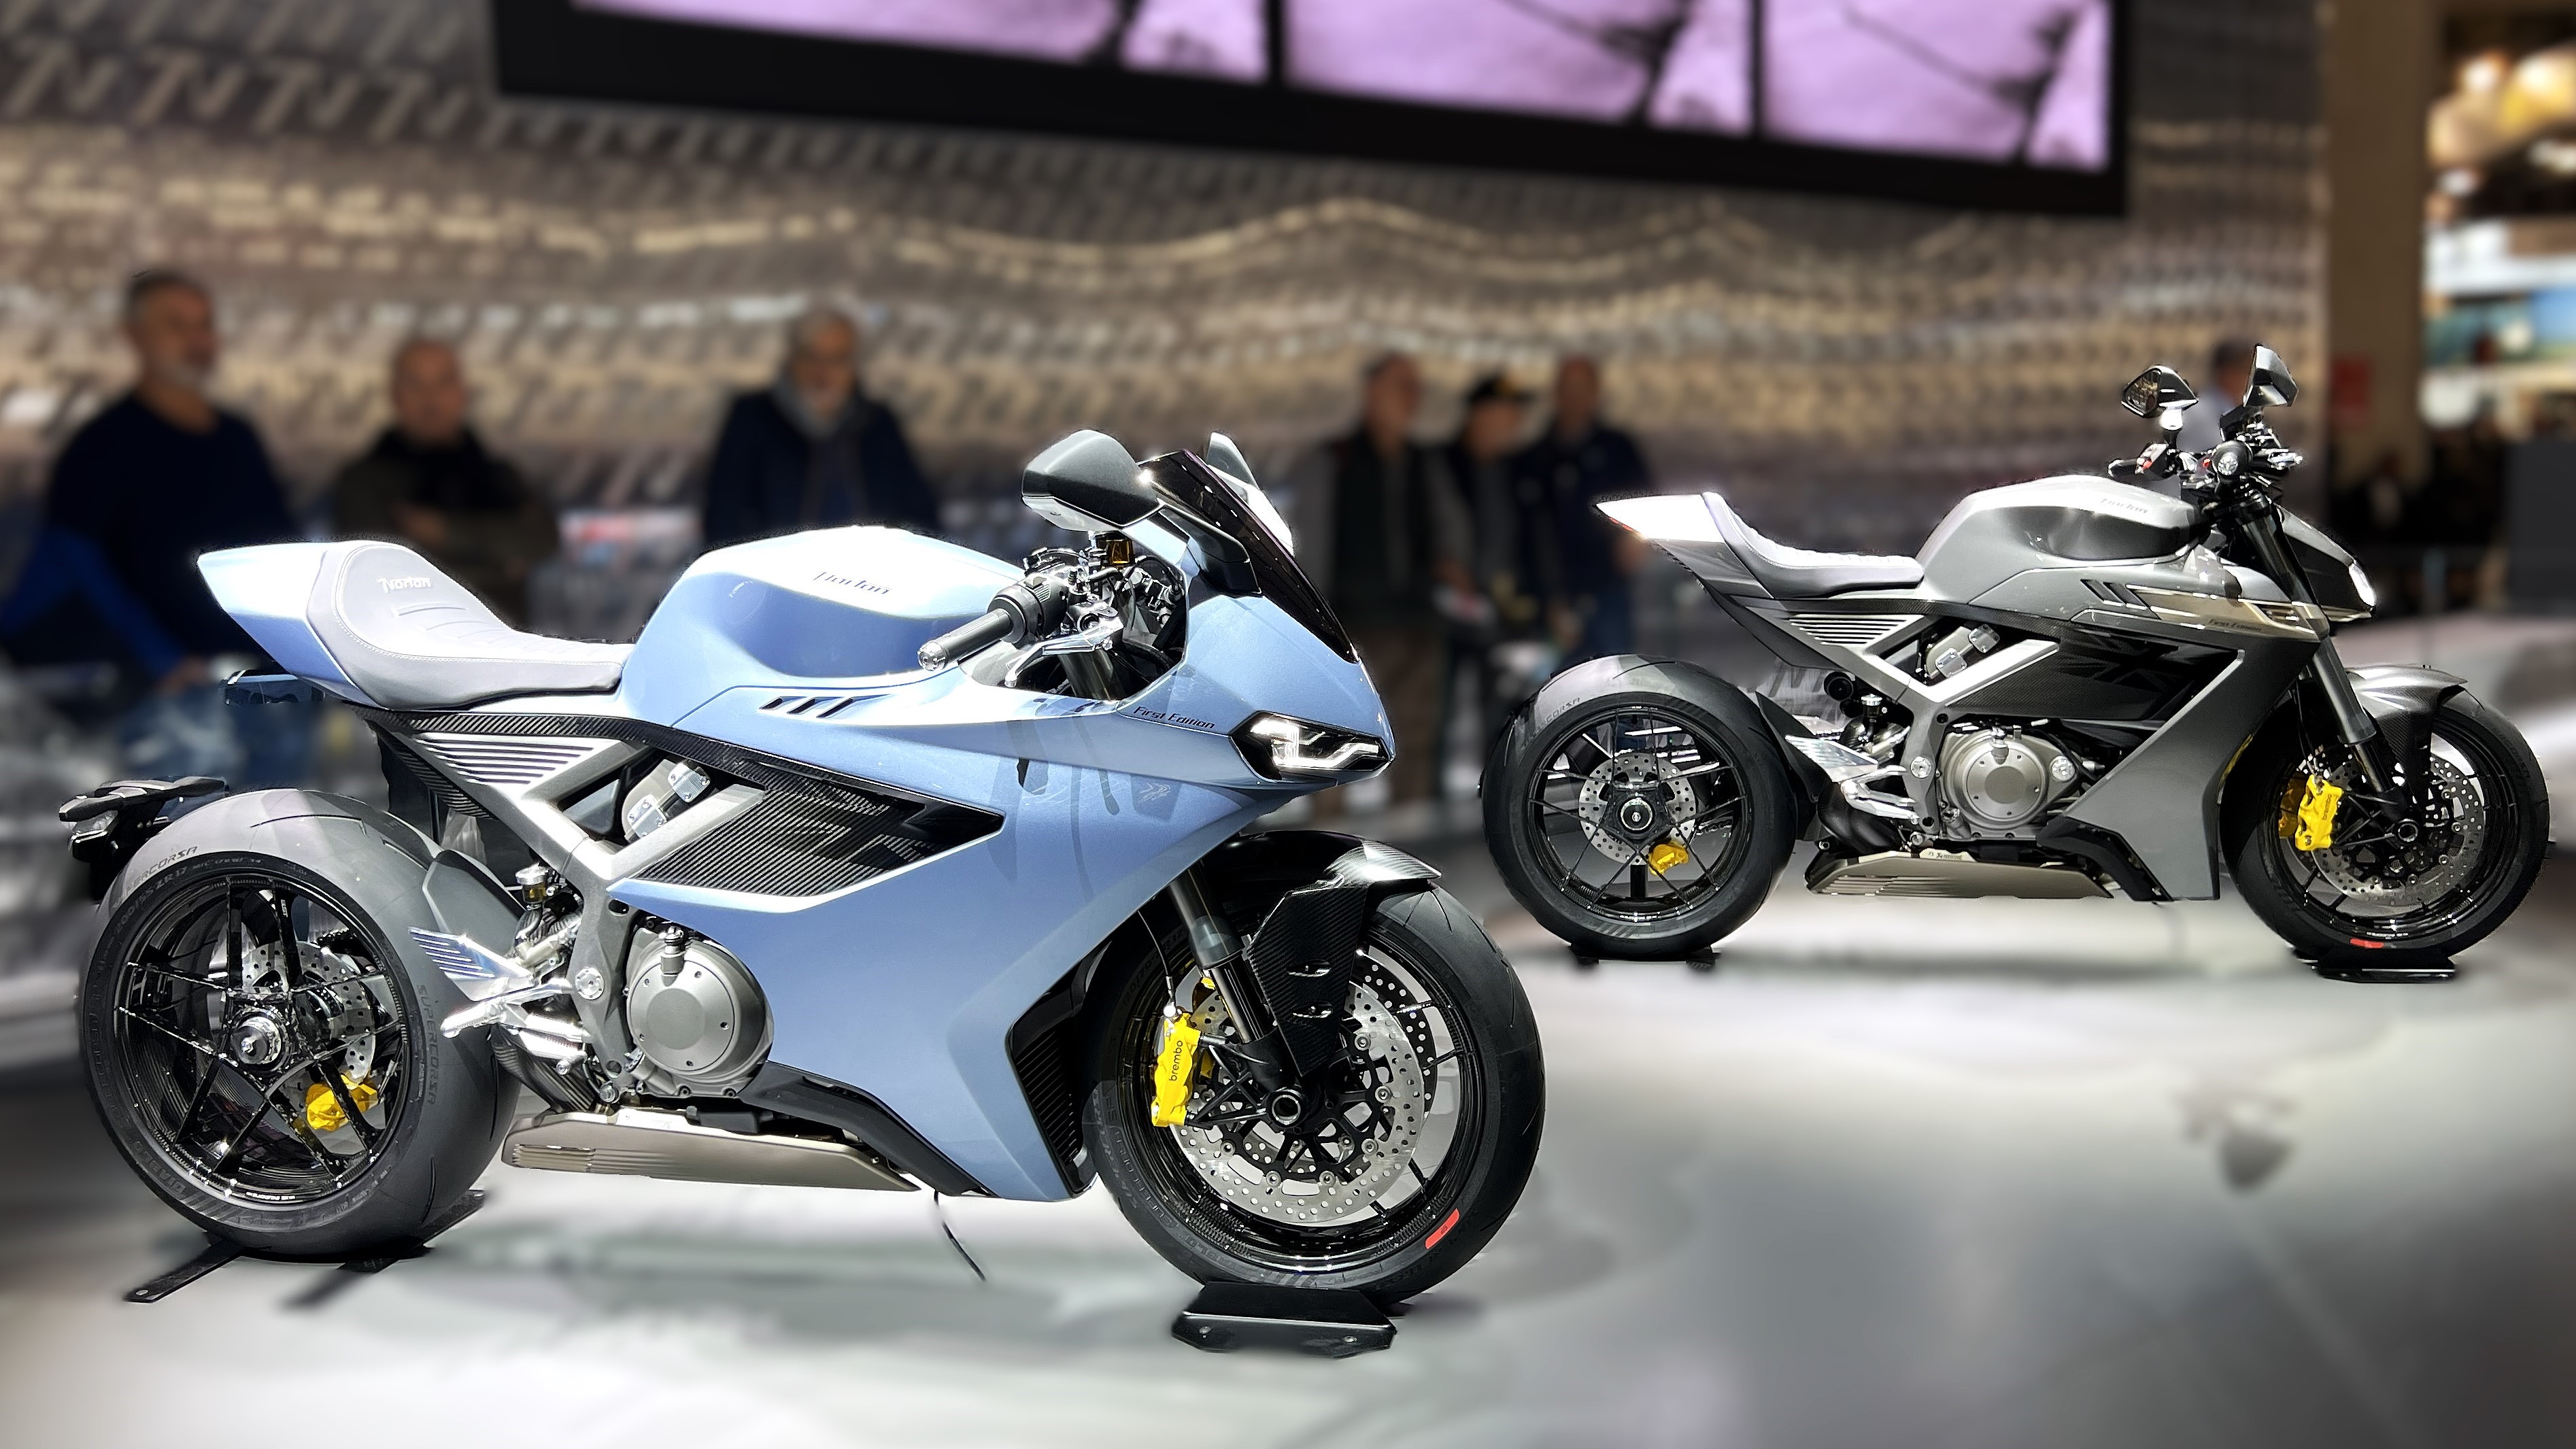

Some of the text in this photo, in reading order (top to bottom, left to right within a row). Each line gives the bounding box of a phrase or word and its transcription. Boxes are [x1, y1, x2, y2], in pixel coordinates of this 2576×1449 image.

[377, 577, 432, 594] Norton
[1134, 706, 1215, 729] First Edition
[418, 985, 440, 1106] SUPERCORSA
[1169, 1040, 1183, 1082] brembo
